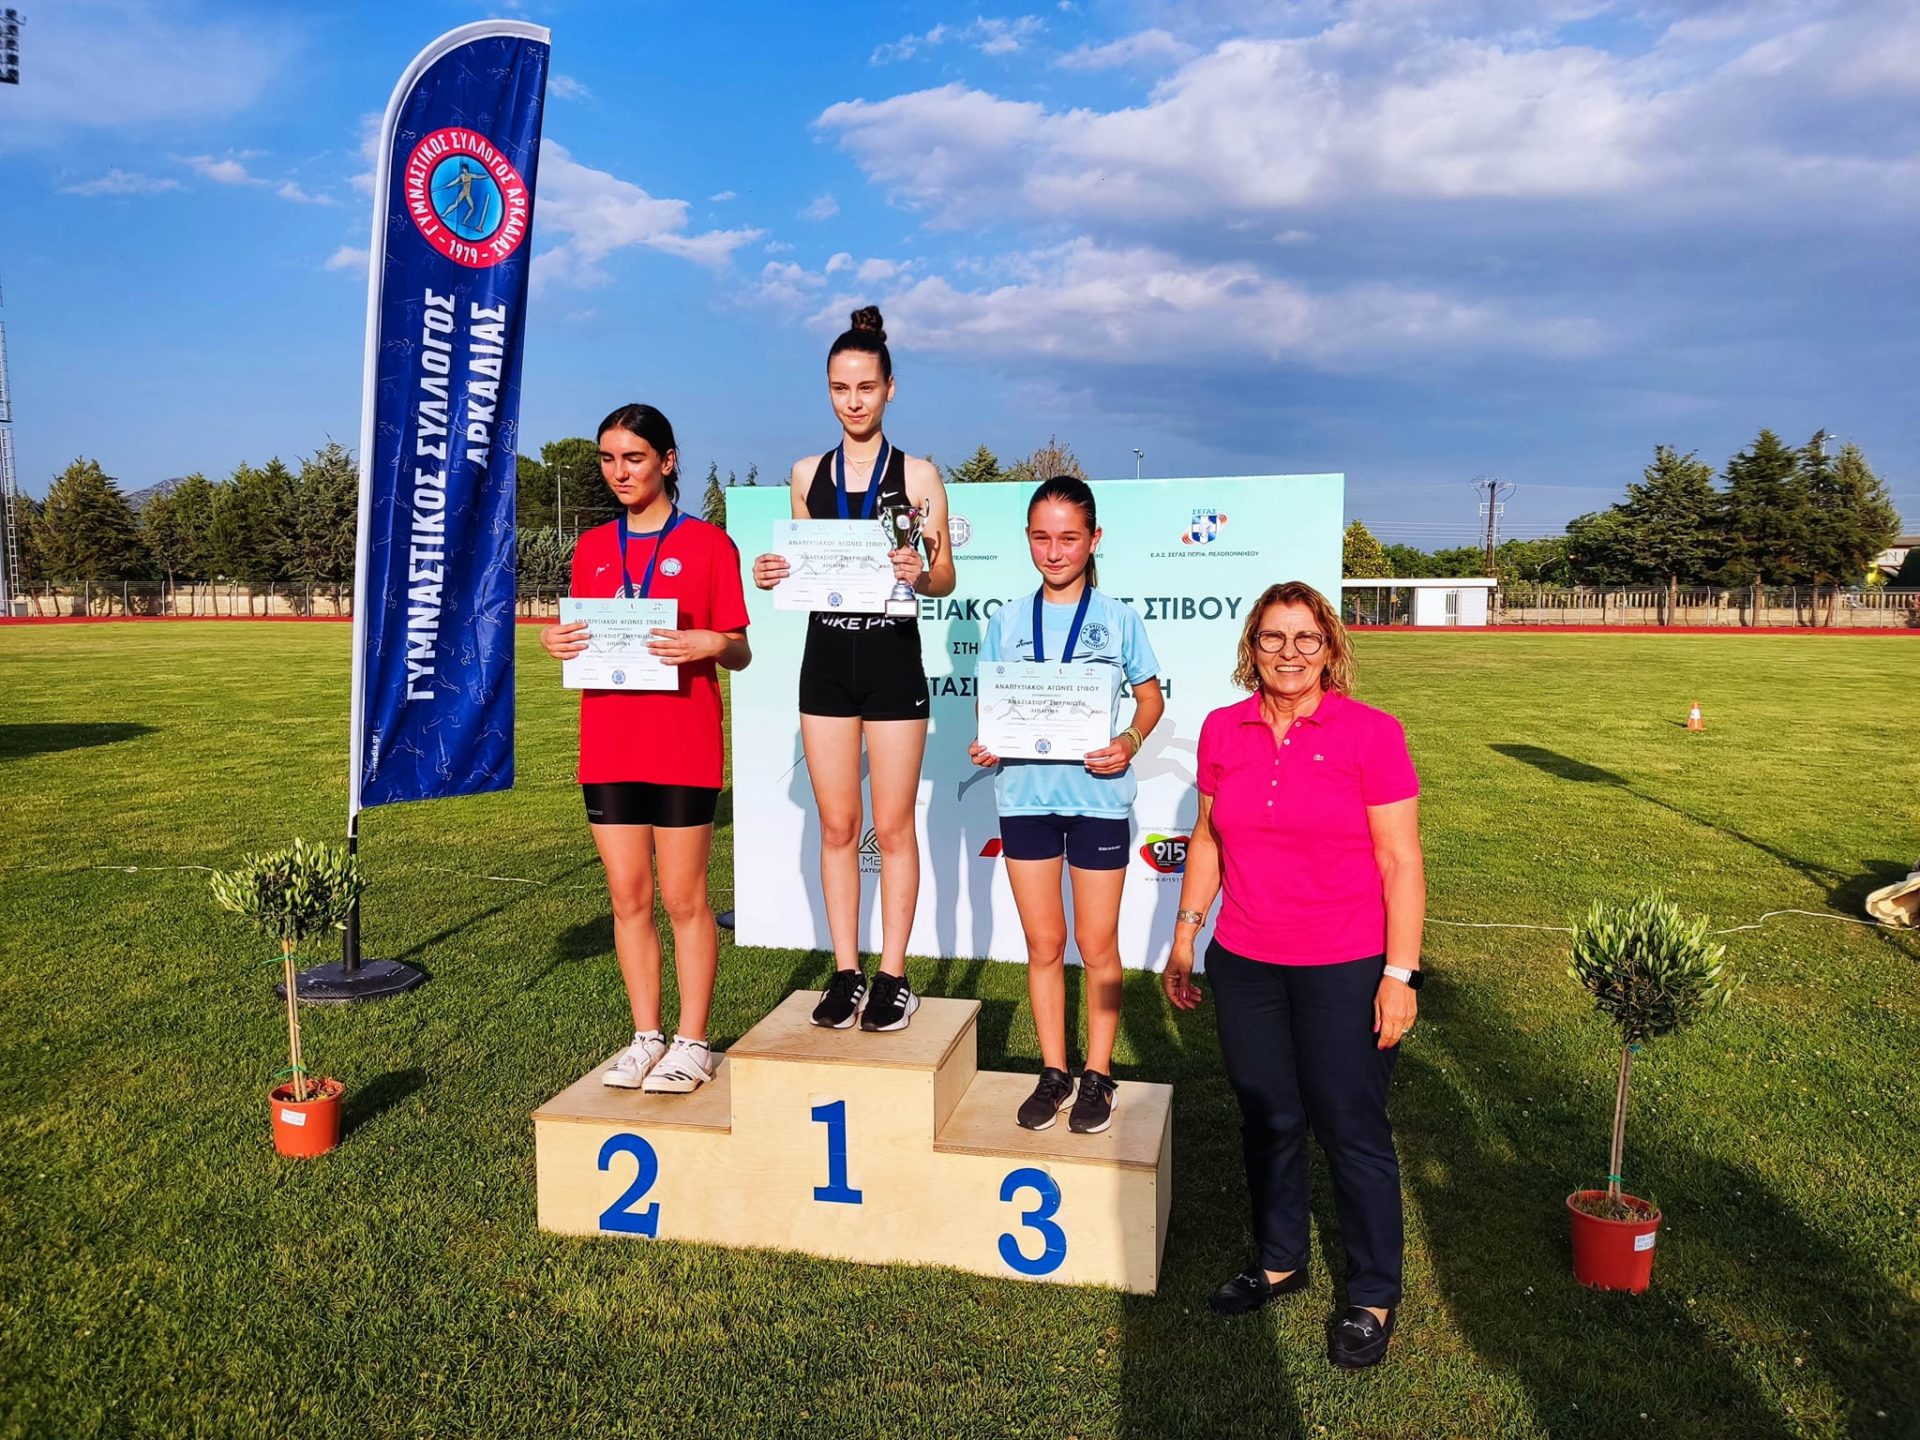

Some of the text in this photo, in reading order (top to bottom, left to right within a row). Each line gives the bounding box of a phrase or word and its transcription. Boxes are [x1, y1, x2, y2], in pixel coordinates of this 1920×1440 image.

[408, 132, 526, 256] ΓΥΜΝΑΣΤΙΚΟΣ ΣΥΛΛΟΓΟΣ ΑΡΚΑΔΙΑΣ
[449, 240, 478, 264] 1979
[467, 302, 506, 468] ΑΡΚΑΔΙΑΣ
[407, 288, 455, 700] ΓΥΜΝΑΣΤΙΚΟΣ ΣΥΛΛΟΓΟΣ
[815, 612, 862, 630] NIKE
[1144, 597, 1242, 620] ΣΤΙΒΟΥ
[1153, 842, 1186, 862] 915
[598, 1133, 660, 1238] 2
[811, 1100, 863, 1204] 1
[998, 1167, 1067, 1275] 3
